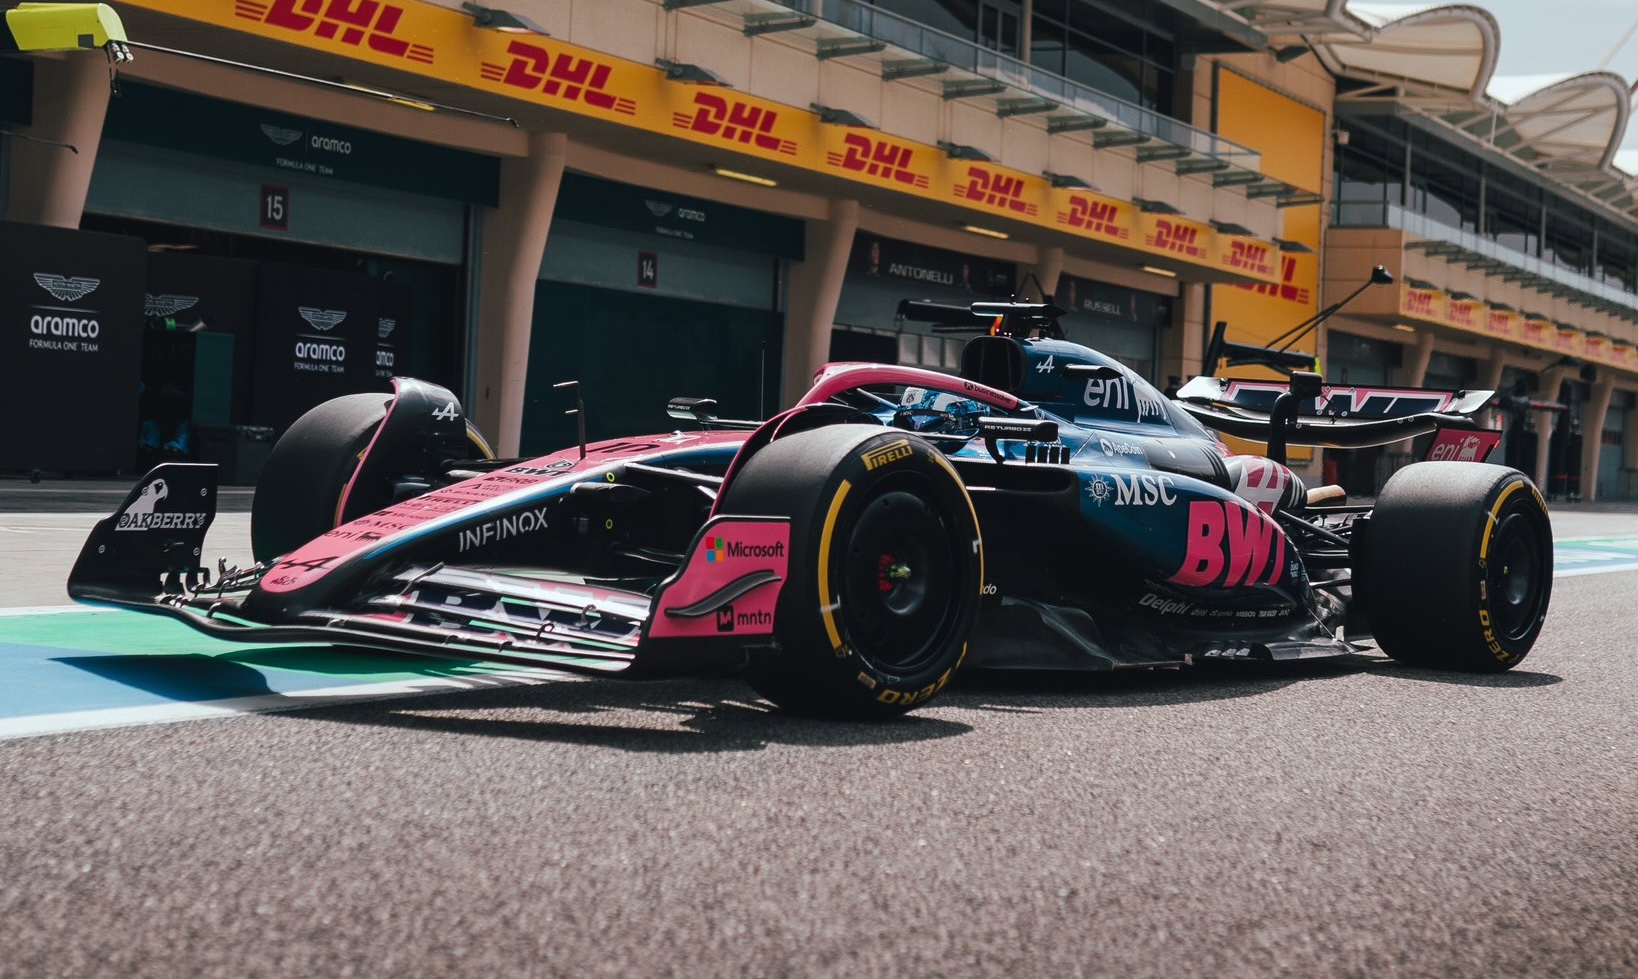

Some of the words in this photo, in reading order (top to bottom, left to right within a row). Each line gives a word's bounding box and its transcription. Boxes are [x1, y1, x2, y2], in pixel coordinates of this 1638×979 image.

[265, 0, 410, 57] DHL
[504, 41, 616, 109] DHL
[691, 92, 781, 151] DHL
[311, 136, 351, 154] aramco
[842, 133, 915, 185] DHL
[966, 167, 1026, 213] DHL
[267, 195, 283, 220] 15
[1068, 195, 1119, 236] DHL
[1154, 219, 1200, 256] DHL
[643, 260, 654, 279] 14
[1230, 241, 1268, 274] DHL
[889, 263, 953, 285] ANTONELLI
[1083, 300, 1122, 316] RUSSELL
[30, 315, 99, 338] aramco
[29, 339, 61, 350] FORMULA
[63, 342, 77, 351] ONE
[81, 343, 98, 351] TEAM
[295, 342, 345, 361] aramco
[860, 439, 913, 471] PIRELLI
[1112, 442, 1143, 456] ApeCoin
[1431, 438, 1464, 461] eni
[505, 467, 570, 477] BWT
[1111, 475, 1177, 506] MSC
[117, 513, 206, 531] OAKBERRY
[459, 507, 548, 552] INFINOX
[728, 541, 784, 557] Microsoft
[1139, 593, 1192, 615] Delphi
[737, 610, 771, 625] mntn
[1479, 610, 1510, 661] ZERO
[876, 668, 951, 705] ZERO
